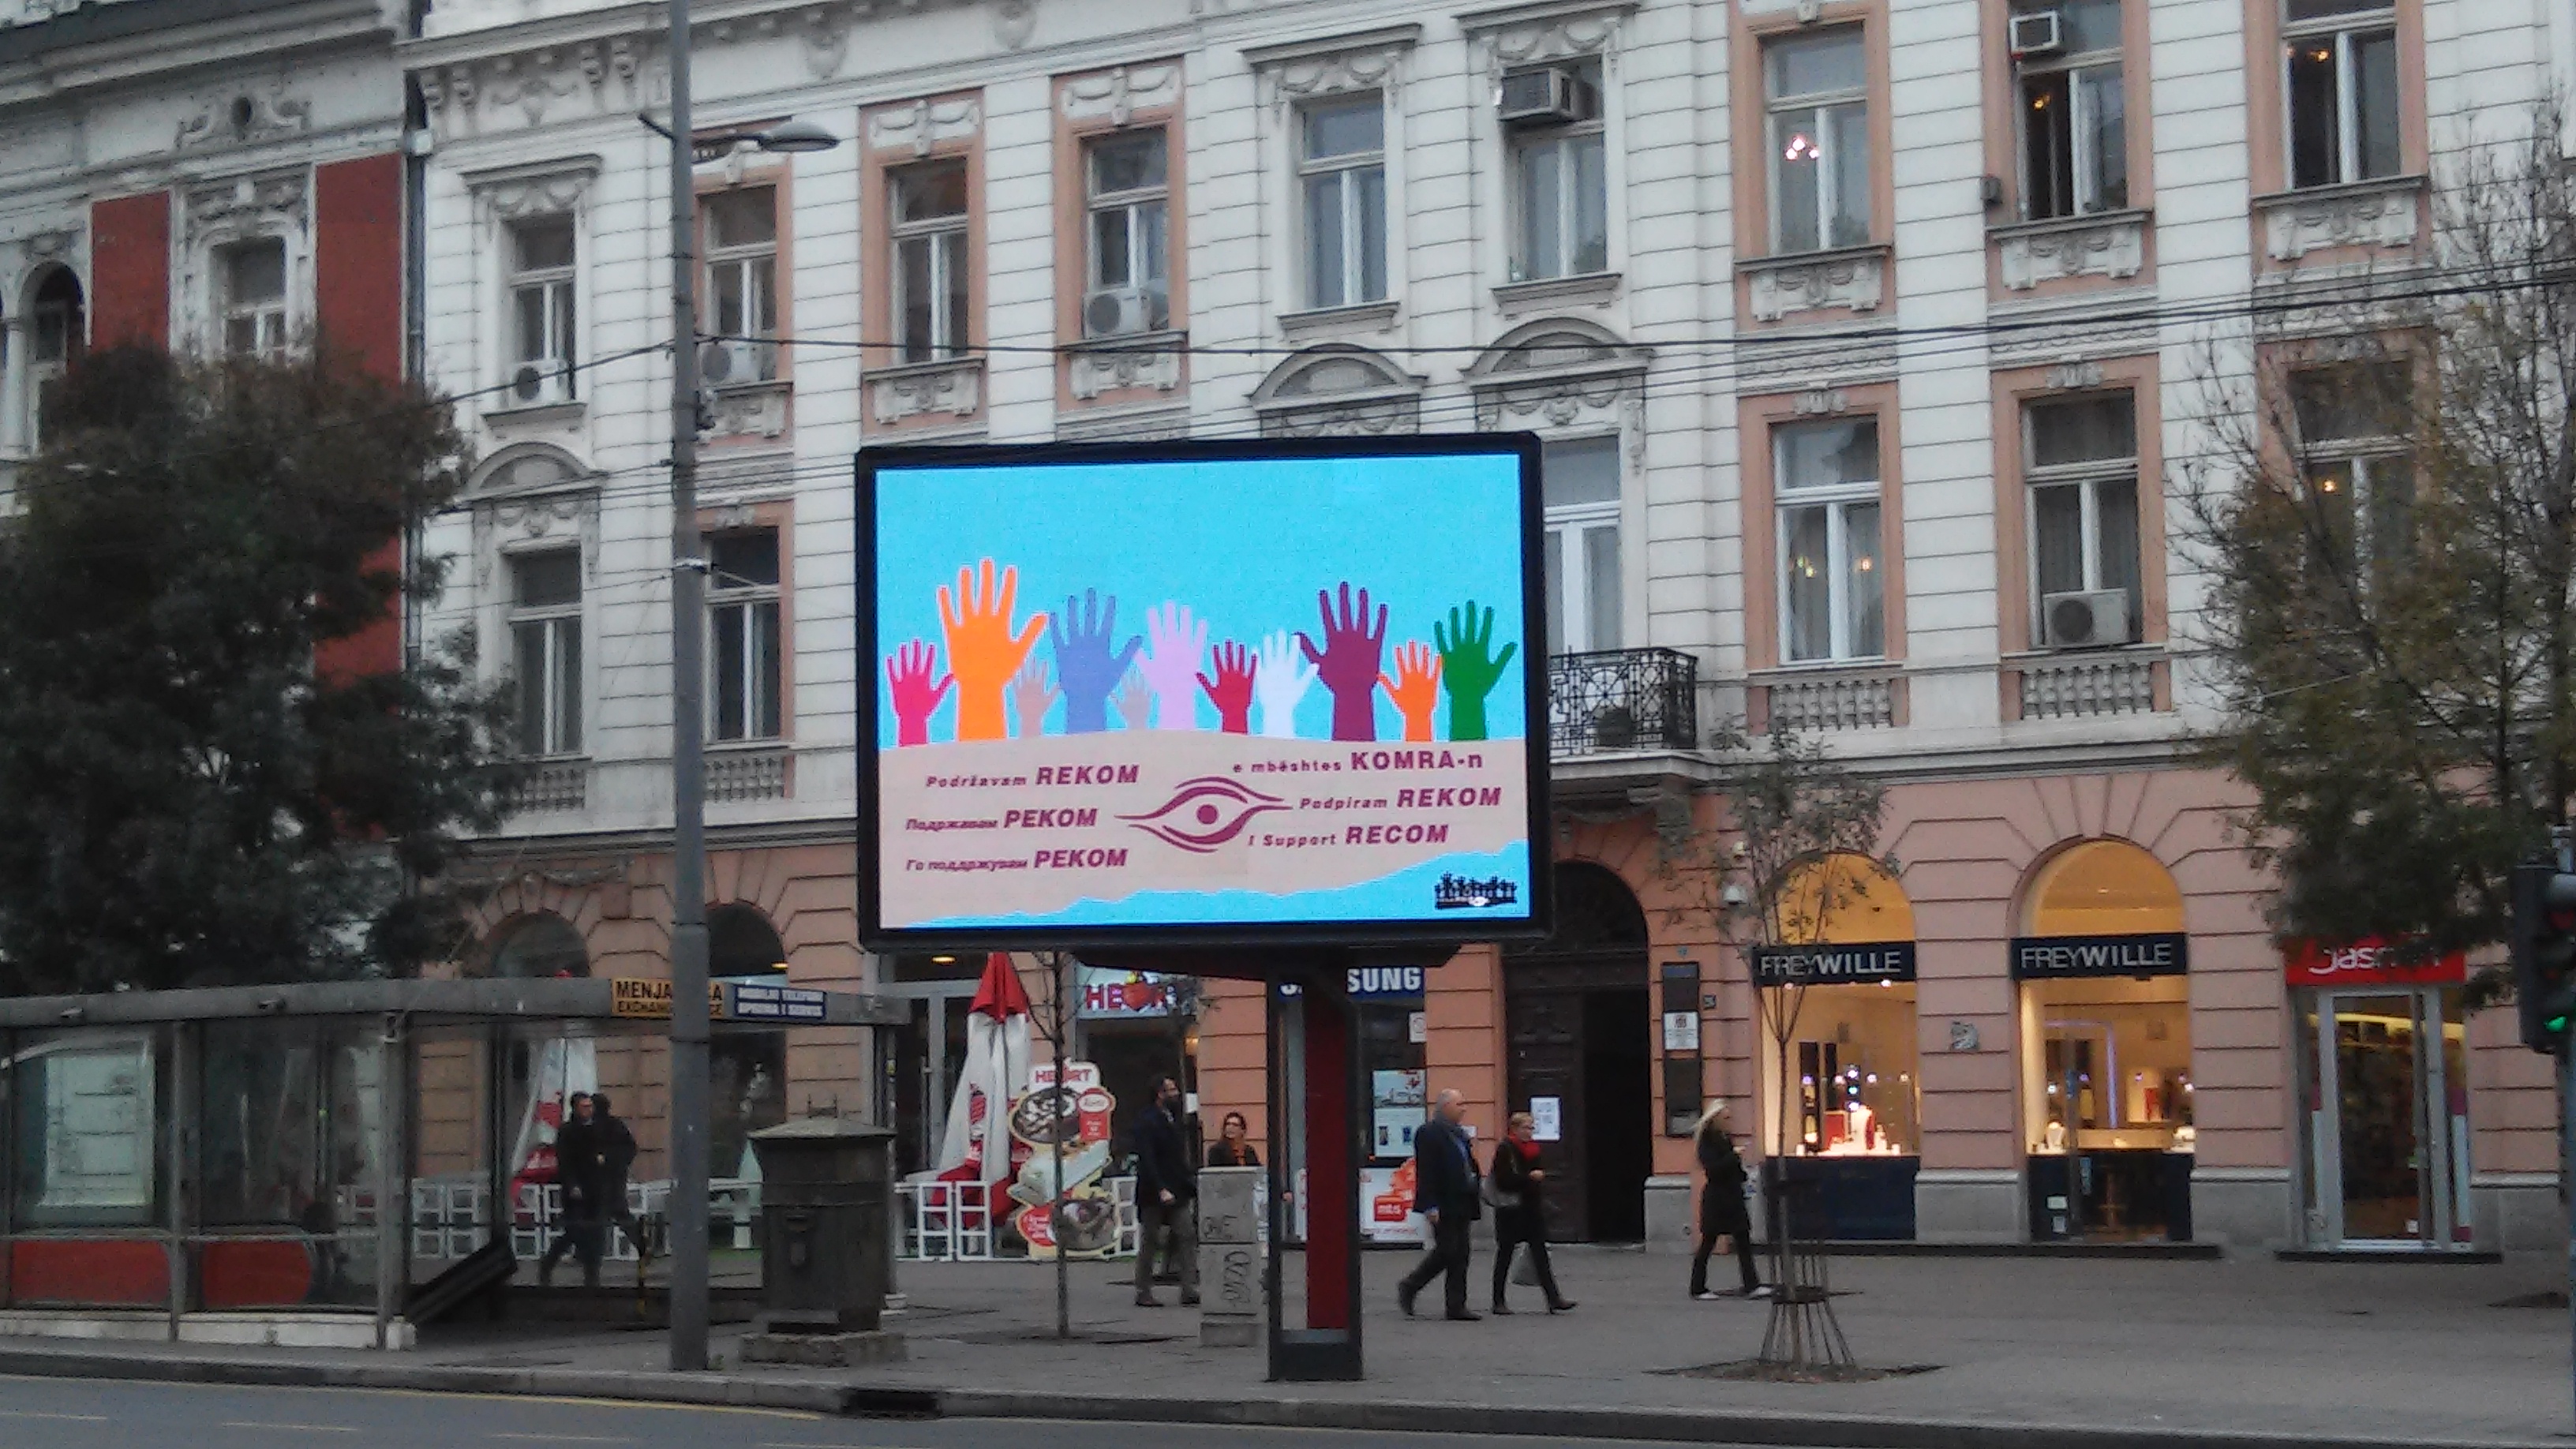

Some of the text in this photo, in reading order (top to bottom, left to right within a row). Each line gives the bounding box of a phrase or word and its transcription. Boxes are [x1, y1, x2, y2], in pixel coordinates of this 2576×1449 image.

[1350, 751, 1484, 771] KOMRA-n
[1035, 765, 1140, 785] REKOM
[1300, 788, 1501, 811] Podpiram REKOM
[1003, 808, 1099, 828] РЕКОМ
[1263, 833, 1337, 848] Support
[1345, 825, 1449, 844] RECOM
[1034, 848, 1129, 868] РЕКОМ
[1759, 950, 1902, 977] FREYWILLE
[2020, 943, 2172, 969] FREYWILLE
[616, 980, 723, 1002] MENJAA
